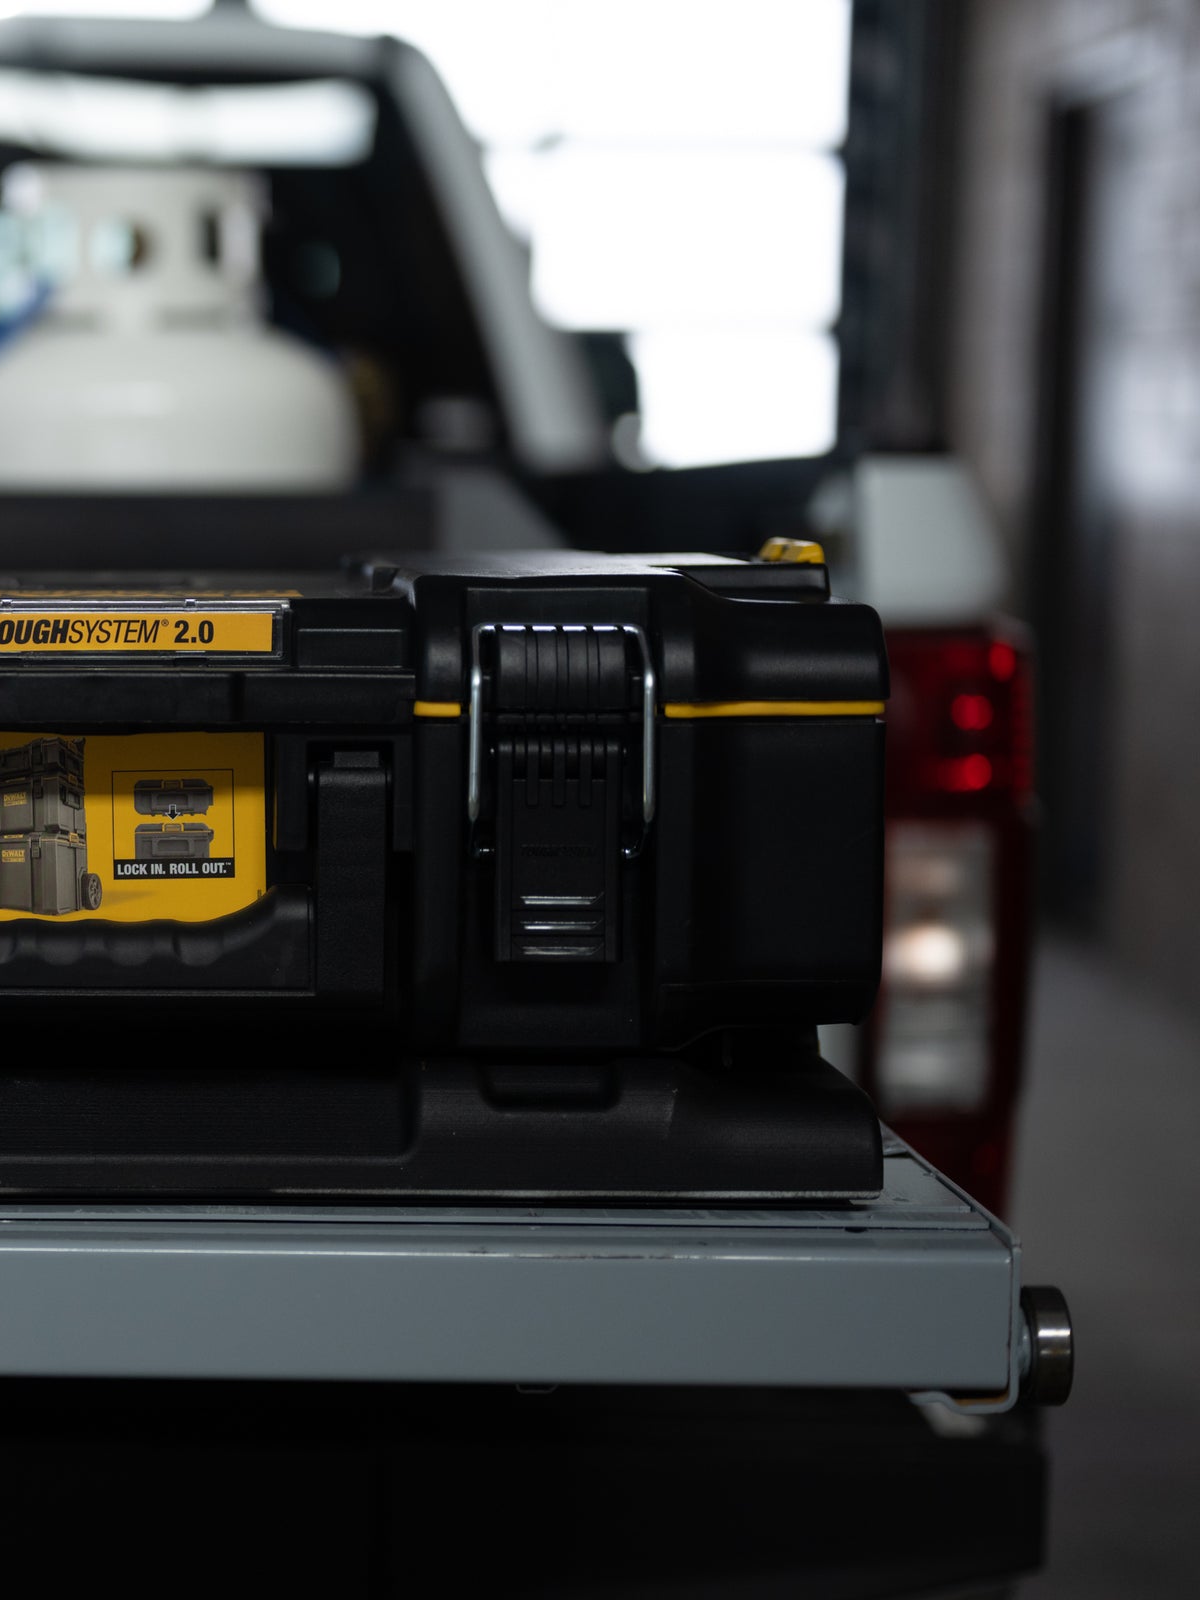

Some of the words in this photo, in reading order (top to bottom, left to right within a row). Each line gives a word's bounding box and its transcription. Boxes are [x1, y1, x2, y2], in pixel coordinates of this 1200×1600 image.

[174, 620, 214, 643] 2.0
[117, 863, 148, 876] LOCK
[150, 863, 166, 875] IN.
[169, 862, 199, 875] ROLL
